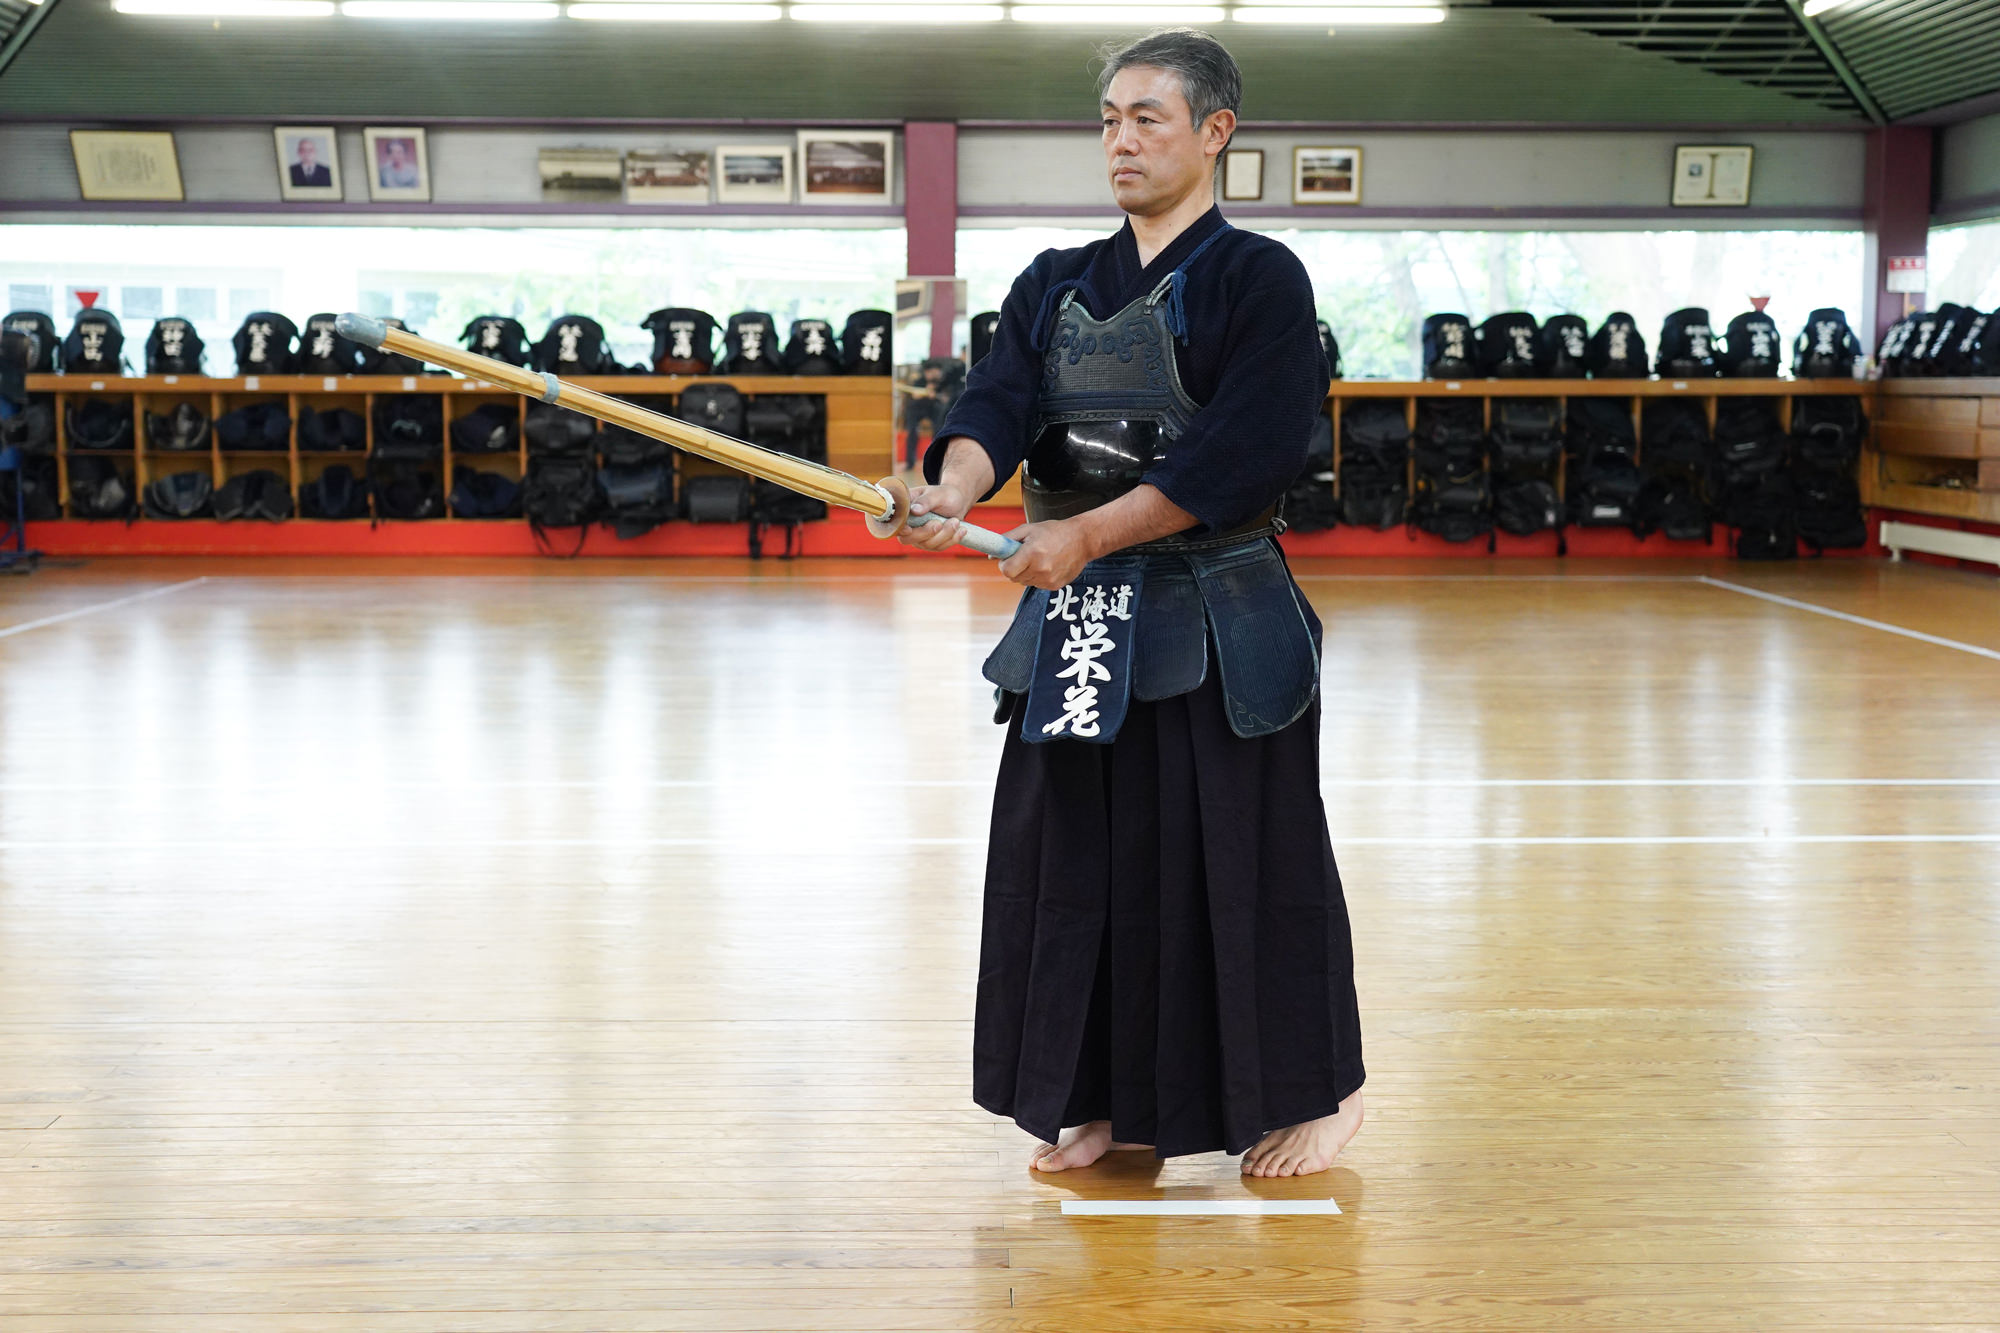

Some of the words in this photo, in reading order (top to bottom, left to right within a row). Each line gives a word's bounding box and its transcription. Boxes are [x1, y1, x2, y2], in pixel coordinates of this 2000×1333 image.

[1046, 584, 1134, 622] 北海道
[1041, 620, 1116, 737] 栄花
